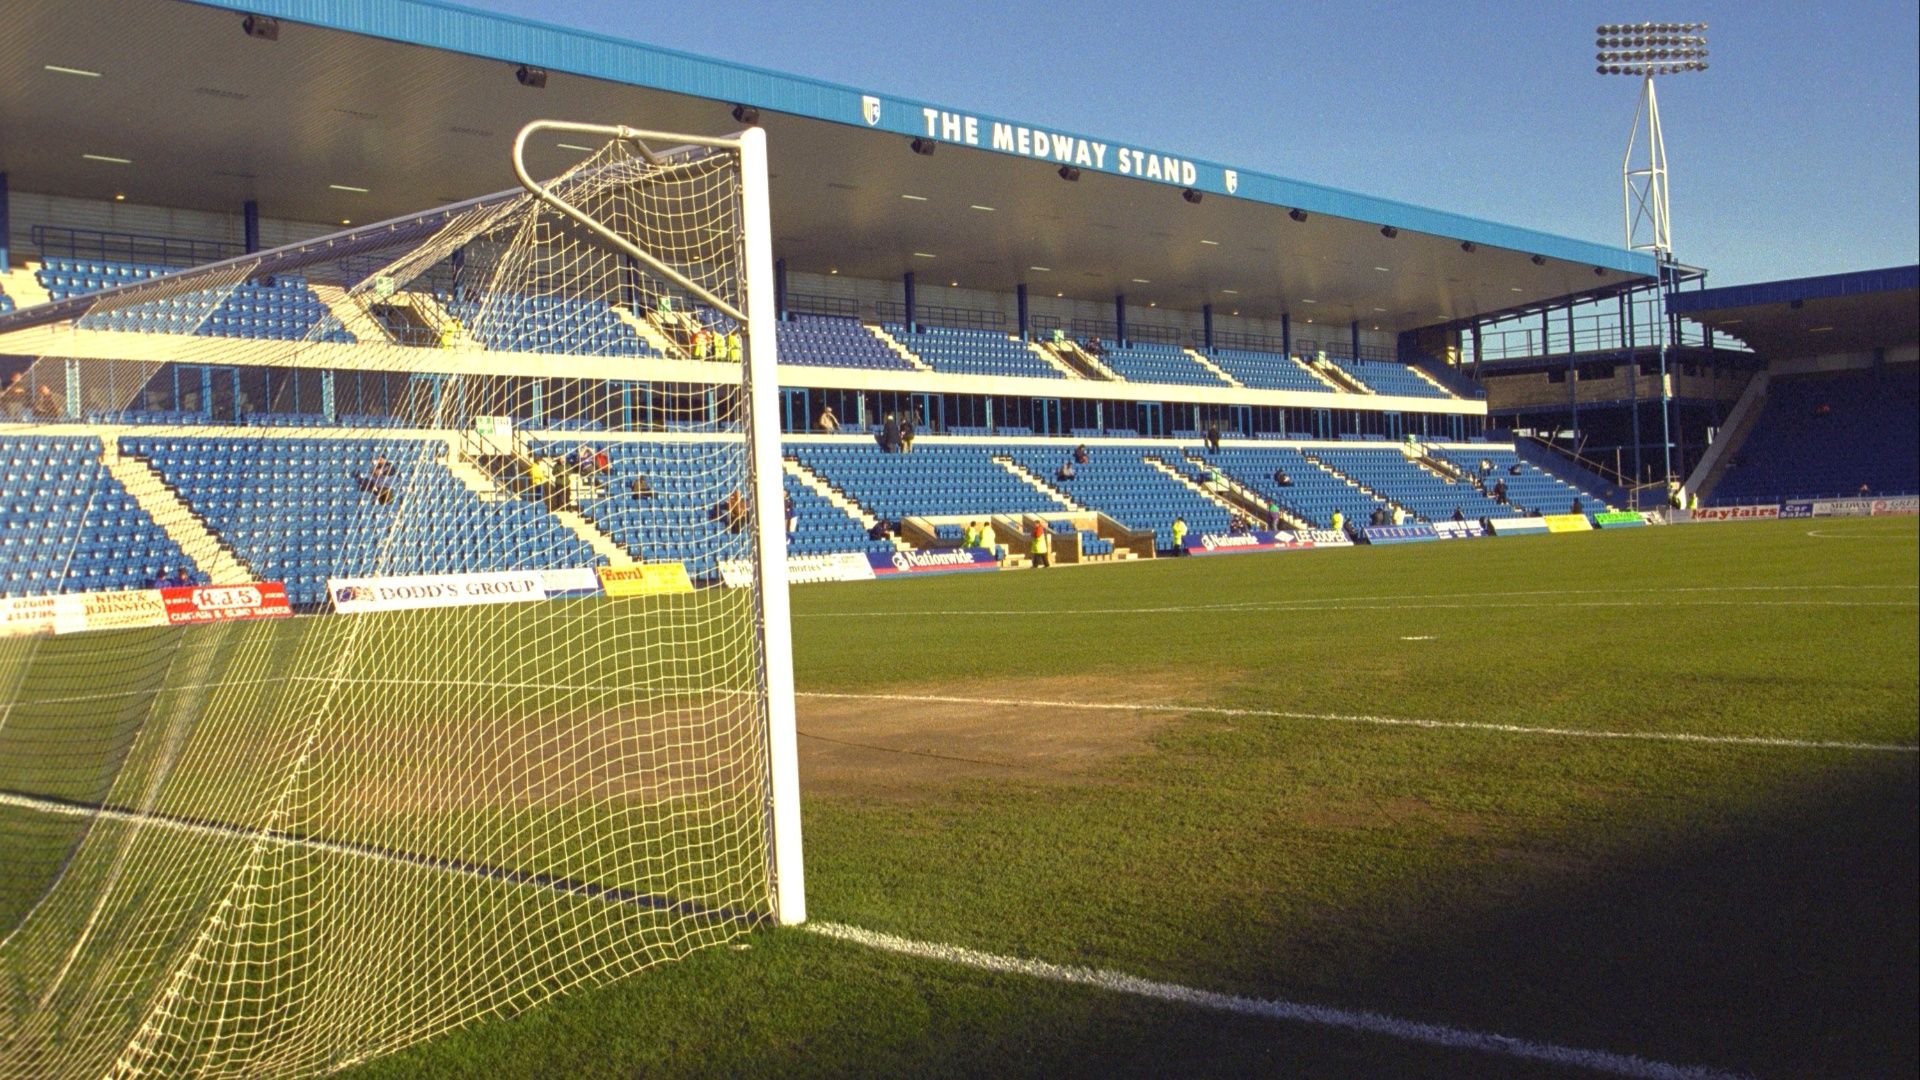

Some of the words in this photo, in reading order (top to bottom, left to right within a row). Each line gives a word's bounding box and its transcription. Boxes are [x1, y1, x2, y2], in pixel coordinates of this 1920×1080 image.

[923, 107, 979, 145] THE
[992, 122, 1107, 169] MEDWAY
[1118, 147, 1197, 186] STAND
[1691, 507, 1778, 519] Mayfairs
[1785, 504, 1808, 512] Car
[1293, 530, 1314, 542] LEE
[1311, 529, 1348, 543] COOPER
[905, 548, 975, 567] Nationwide
[379, 583, 459, 600] DODD'S
[465, 580, 535, 596] GROUP
[95, 593, 133, 603] KING
[85, 600, 162, 616] JOHNSTON
